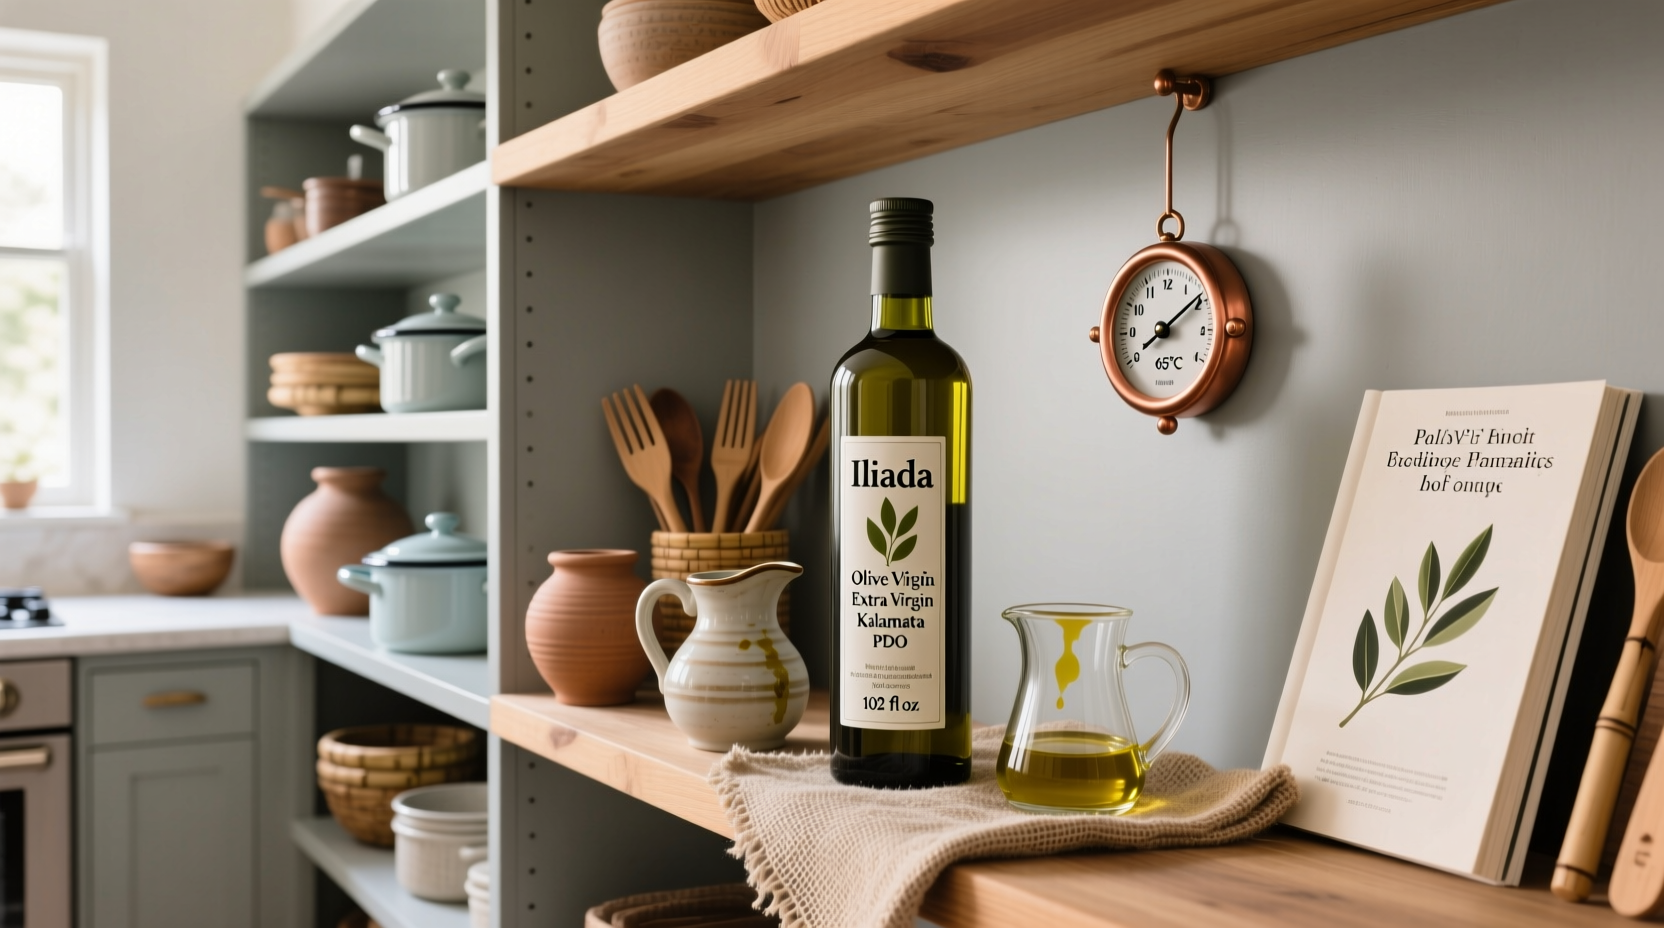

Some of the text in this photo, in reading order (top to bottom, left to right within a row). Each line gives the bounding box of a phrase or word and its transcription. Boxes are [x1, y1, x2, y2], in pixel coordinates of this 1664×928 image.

[1163, 279, 1173, 290] 12
[1134, 304, 1145, 316] 10
[851, 458, 934, 489] Iliada
[851, 569, 889, 586] Olive
[852, 591, 934, 612] Extra Virgin
[857, 612, 925, 629] Kalamata
[873, 634, 908, 649] PDO
[863, 695, 920, 712] 102 fl oz
